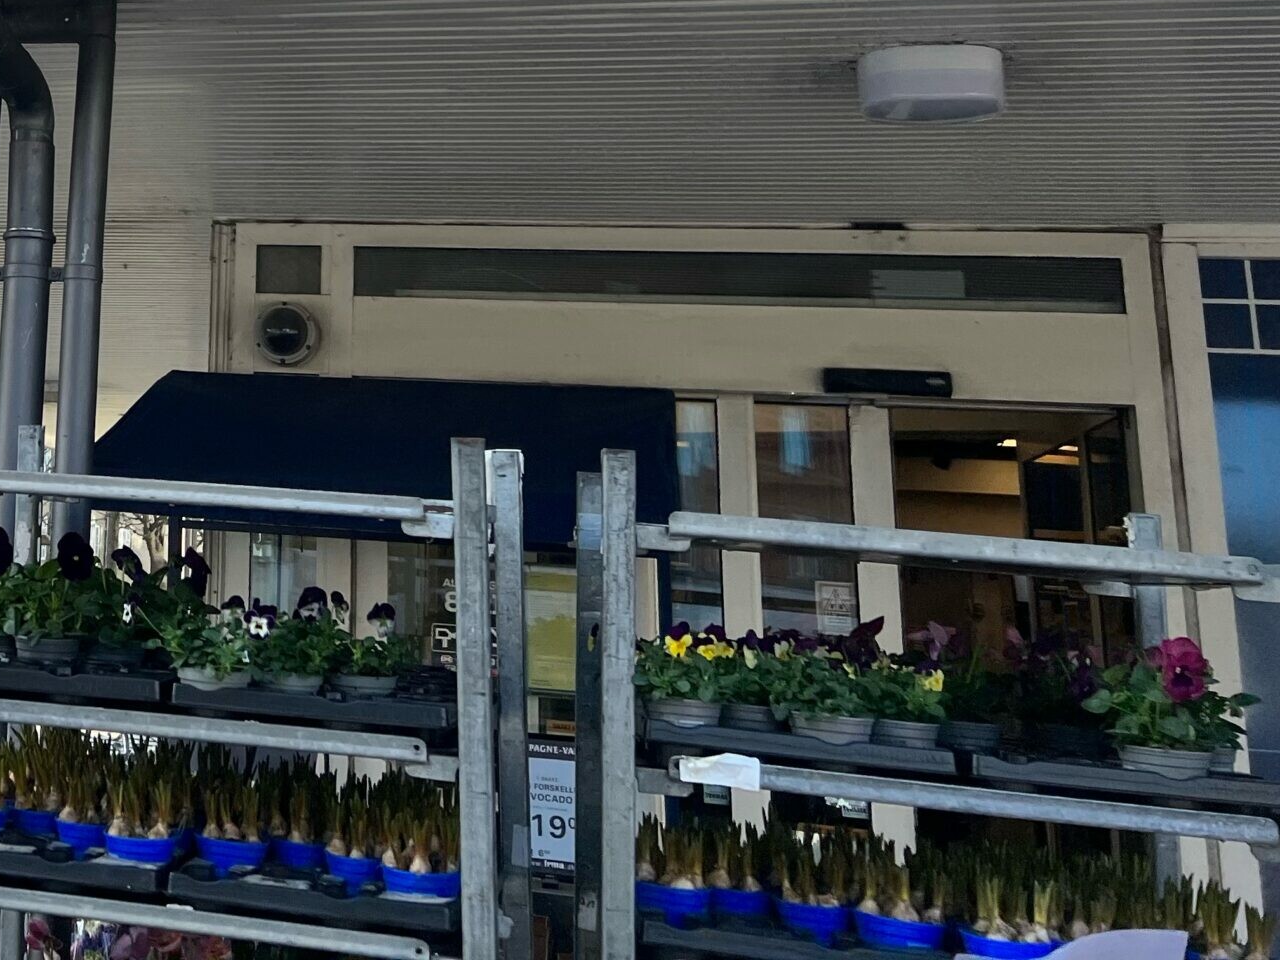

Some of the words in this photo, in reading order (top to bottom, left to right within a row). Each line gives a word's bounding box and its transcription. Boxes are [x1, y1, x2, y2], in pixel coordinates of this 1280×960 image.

[529, 744, 575, 755] PAGNE-VA
[534, 783, 575, 794] FORSKELL
[529, 792, 573, 804] VOCADO
